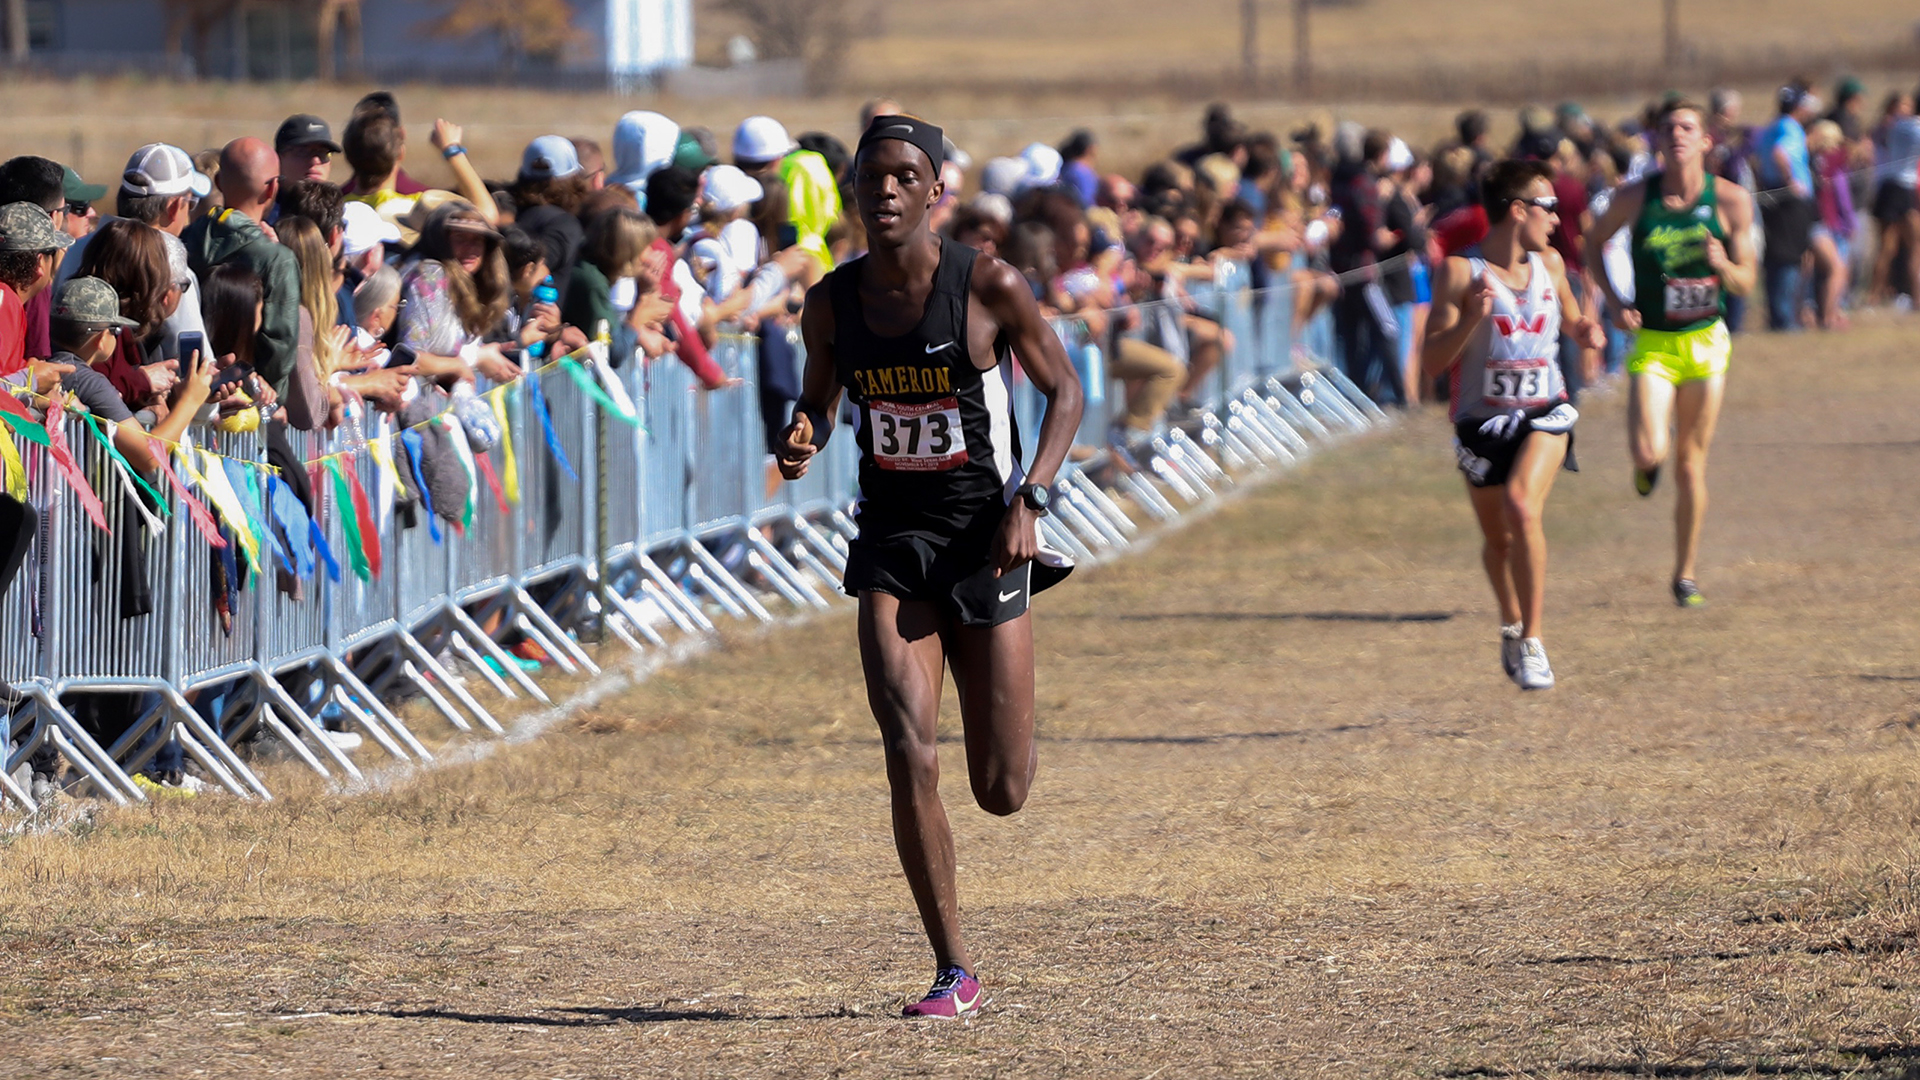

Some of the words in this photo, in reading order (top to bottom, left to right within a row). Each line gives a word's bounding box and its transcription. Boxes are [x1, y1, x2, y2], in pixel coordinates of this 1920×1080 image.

[854, 366, 951, 396] CAMERON
[1492, 369, 1538, 396] 573
[880, 413, 952, 456] 373
[40, 510, 51, 565] FRIEDRICHS
